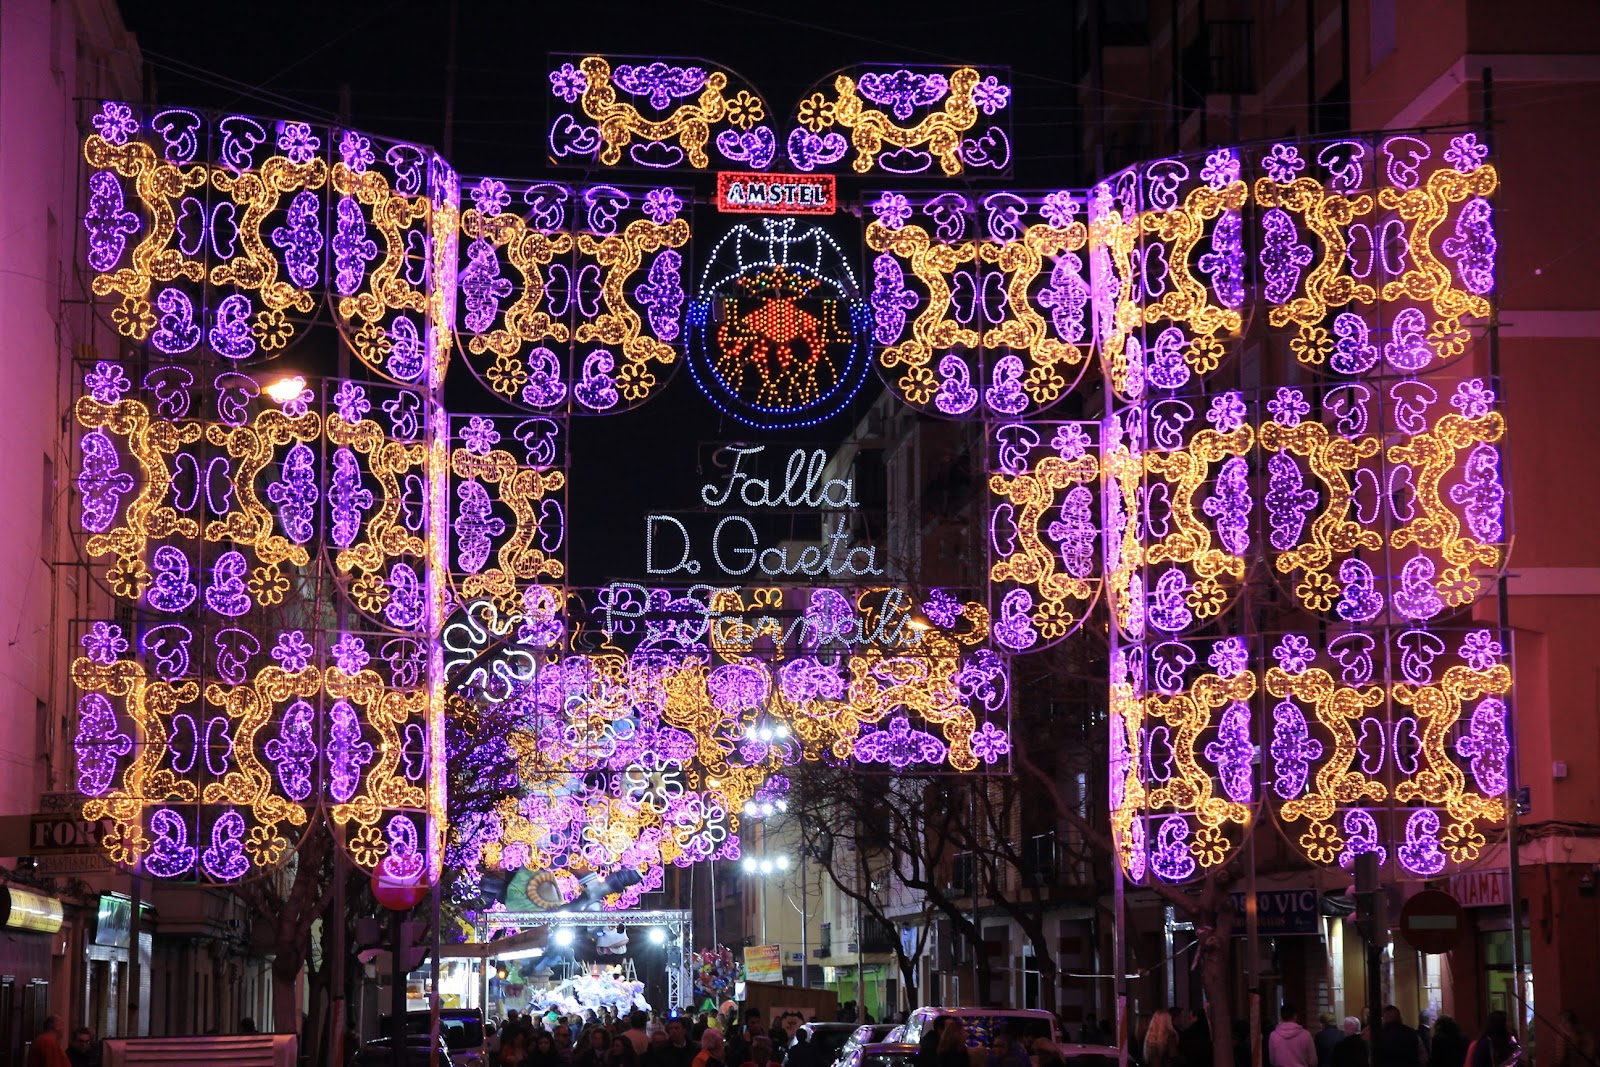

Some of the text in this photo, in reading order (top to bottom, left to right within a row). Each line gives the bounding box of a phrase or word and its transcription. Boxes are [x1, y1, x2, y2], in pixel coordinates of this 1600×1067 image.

[726, 181, 828, 206] AMSTEL
[700, 443, 860, 507] Falla
[712, 515, 884, 576] Gaeta
[1274, 891, 1315, 914] VIC
[1452, 872, 1501, 905] KIAMA
